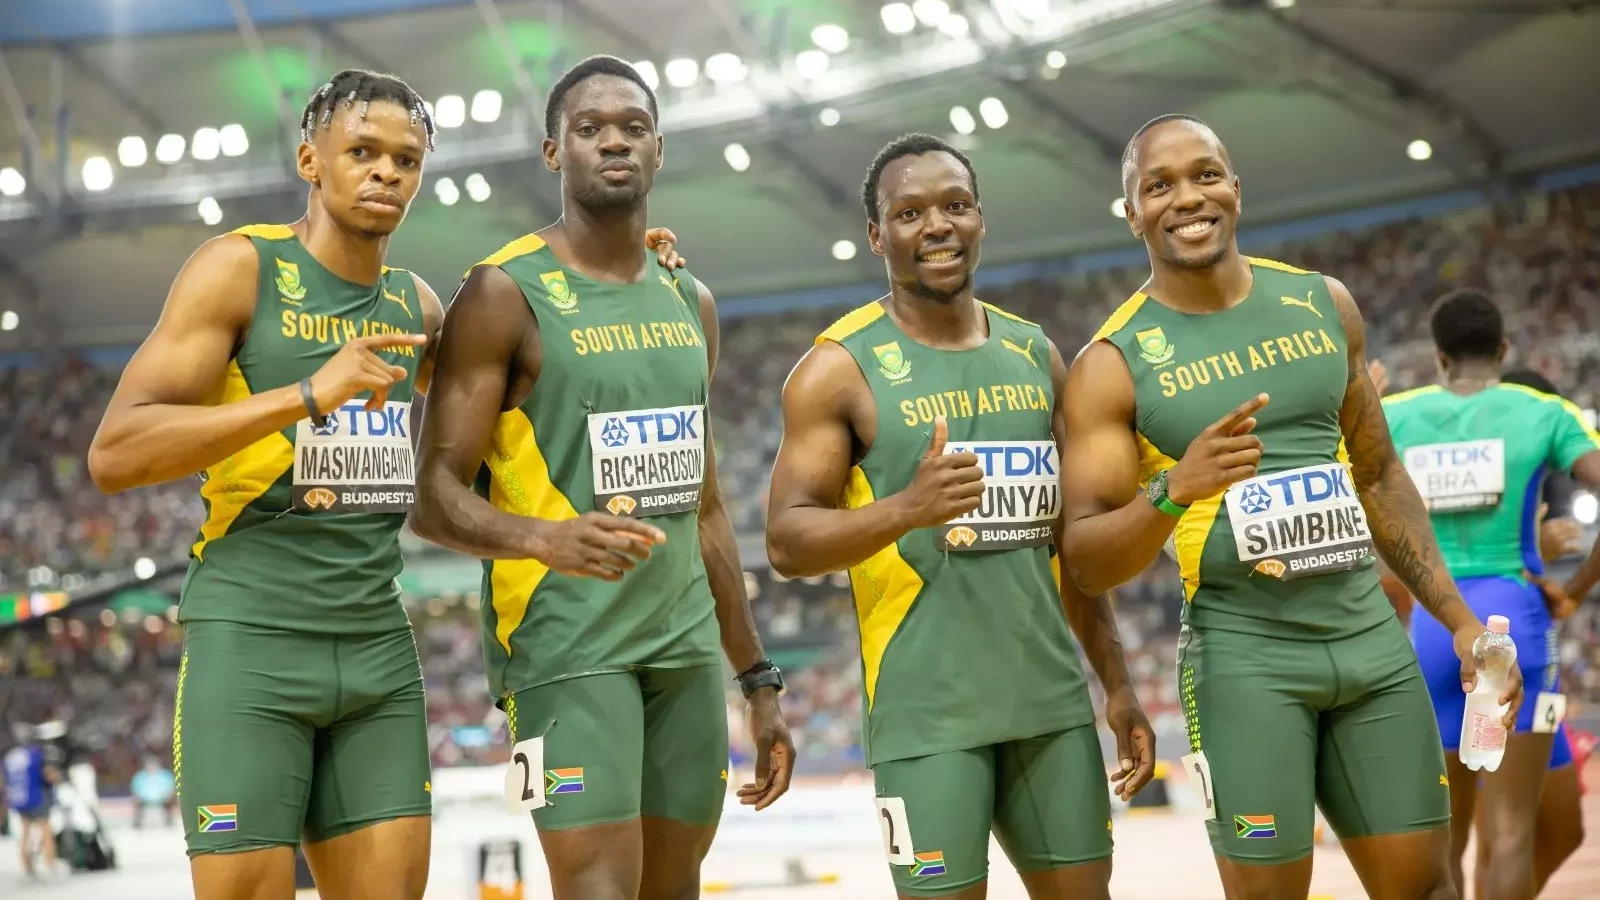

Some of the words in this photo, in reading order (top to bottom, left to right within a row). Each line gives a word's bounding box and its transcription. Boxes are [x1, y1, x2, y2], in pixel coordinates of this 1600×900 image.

[281, 309, 358, 344] SOUTH
[571, 324, 638, 356] SOUTH
[641, 321, 702, 348] AFRICA
[1158, 351, 1245, 398] SOUTH
[1248, 329, 1338, 371] AFRICA
[340, 404, 407, 437] TDK
[901, 389, 973, 427] SOUTH
[977, 384, 1049, 415] AFRICA
[626, 410, 698, 444] TDK
[301, 446, 413, 480] MASWANGANYI
[600, 449, 701, 490] RICHARDSON
[974, 446, 1055, 476] TDK
[1433, 445, 1492, 467] TDK
[342, 492, 404, 504] BUDAPEST
[641, 491, 693, 508] BUDAPEST
[1267, 468, 1350, 507] TDK
[1427, 471, 1477, 494] BRA
[957, 485, 1057, 518] UNYAI
[982, 528, 1040, 542] BUDAPEST
[1244, 505, 1366, 556] SIMBINE
[1290, 549, 1358, 571] BUDAPEST
[514, 752, 534, 801] 2
[881, 807, 901, 855] 2
